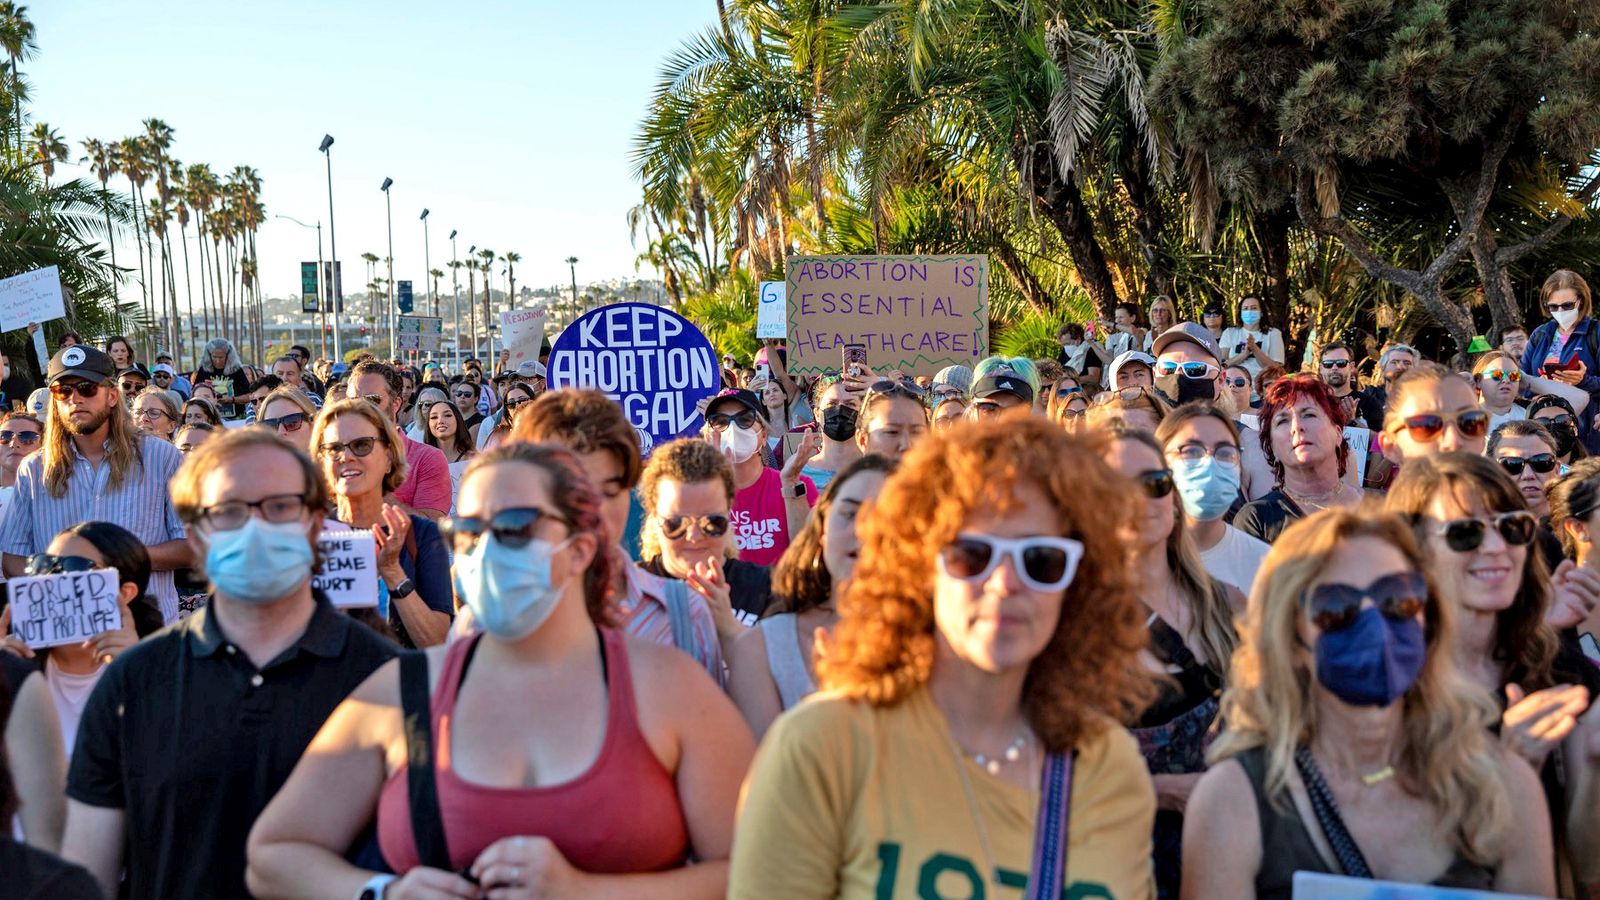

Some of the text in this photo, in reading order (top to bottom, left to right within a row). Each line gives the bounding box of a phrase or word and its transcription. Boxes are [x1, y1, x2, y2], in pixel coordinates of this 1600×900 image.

[579, 306, 683, 348] KEEP
[552, 346, 713, 393] ABORTION
[606, 391, 700, 435] GAL
[729, 509, 751, 525] NS
[739, 518, 782, 538] OUR
[732, 533, 775, 551] DIES
[14, 573, 107, 604] FORCED
[311, 577, 356, 591] OURT
[28, 593, 116, 619] BIRTH IS
[14, 618, 48, 642] NOT
